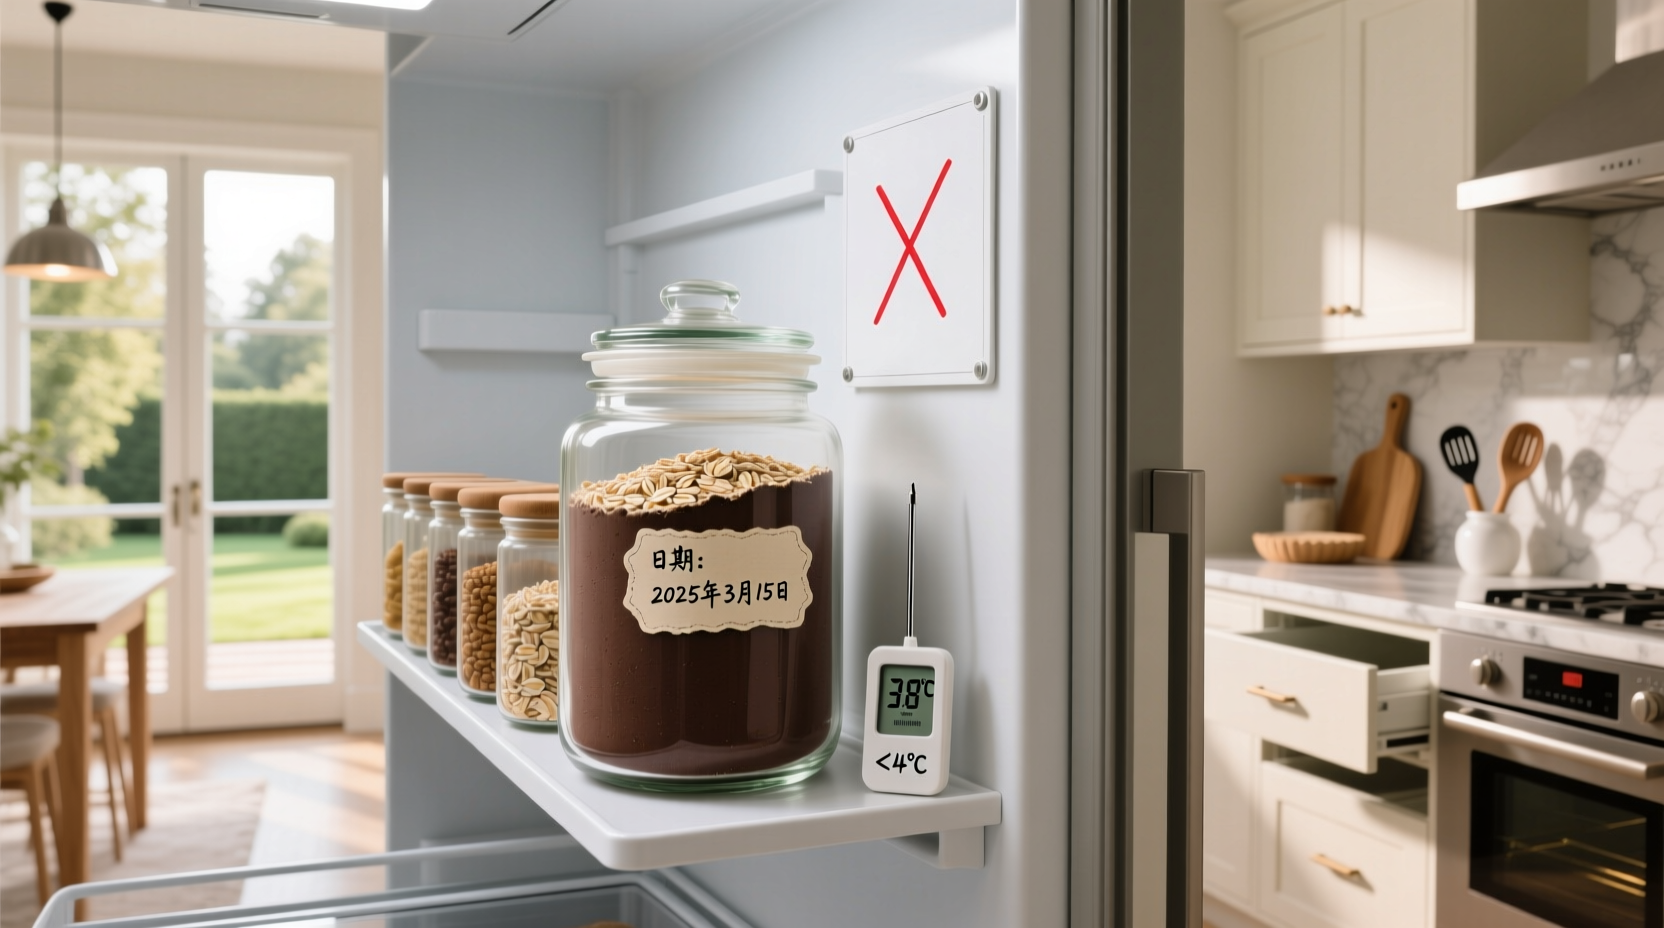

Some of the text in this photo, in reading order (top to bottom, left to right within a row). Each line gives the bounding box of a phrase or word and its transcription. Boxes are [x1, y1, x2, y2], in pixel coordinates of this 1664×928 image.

[652, 545, 704, 572] 日期：
[651, 580, 788, 609] 2025年3月15日
[875, 752, 927, 774] <4°C
